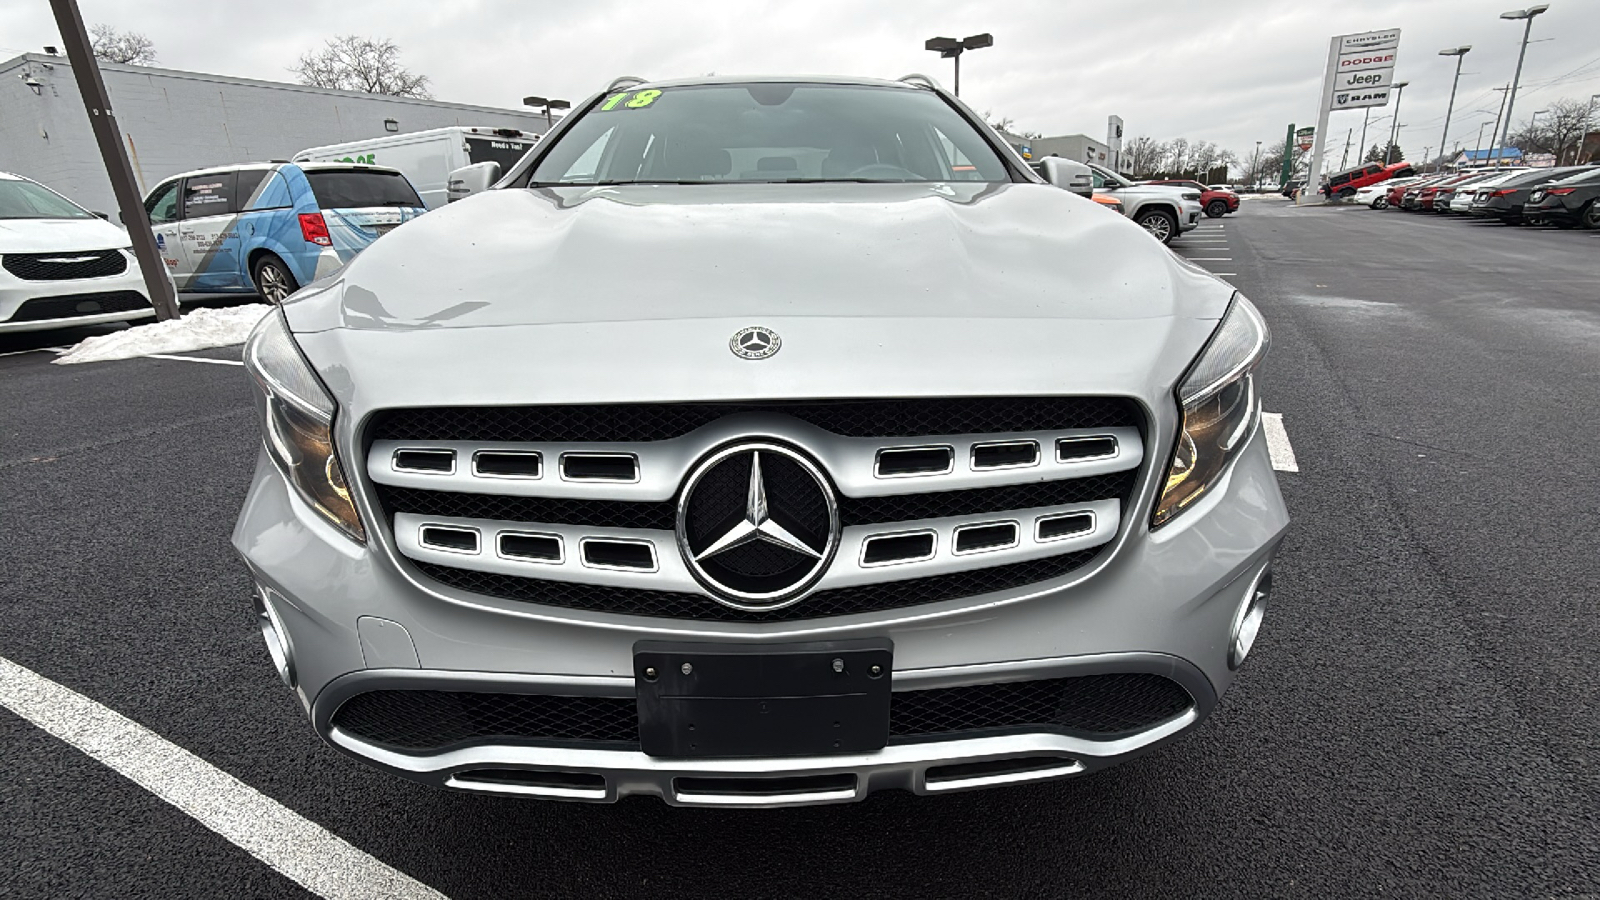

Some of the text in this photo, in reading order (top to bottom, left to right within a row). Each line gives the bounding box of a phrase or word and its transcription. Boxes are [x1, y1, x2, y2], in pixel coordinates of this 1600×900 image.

[1346, 34, 1396, 43] CHRYSLER
[1341, 55, 1394, 66] DODGE
[1347, 73, 1382, 85] Jeep
[601, 89, 662, 111] 18
[1350, 93, 1387, 101] RAM
